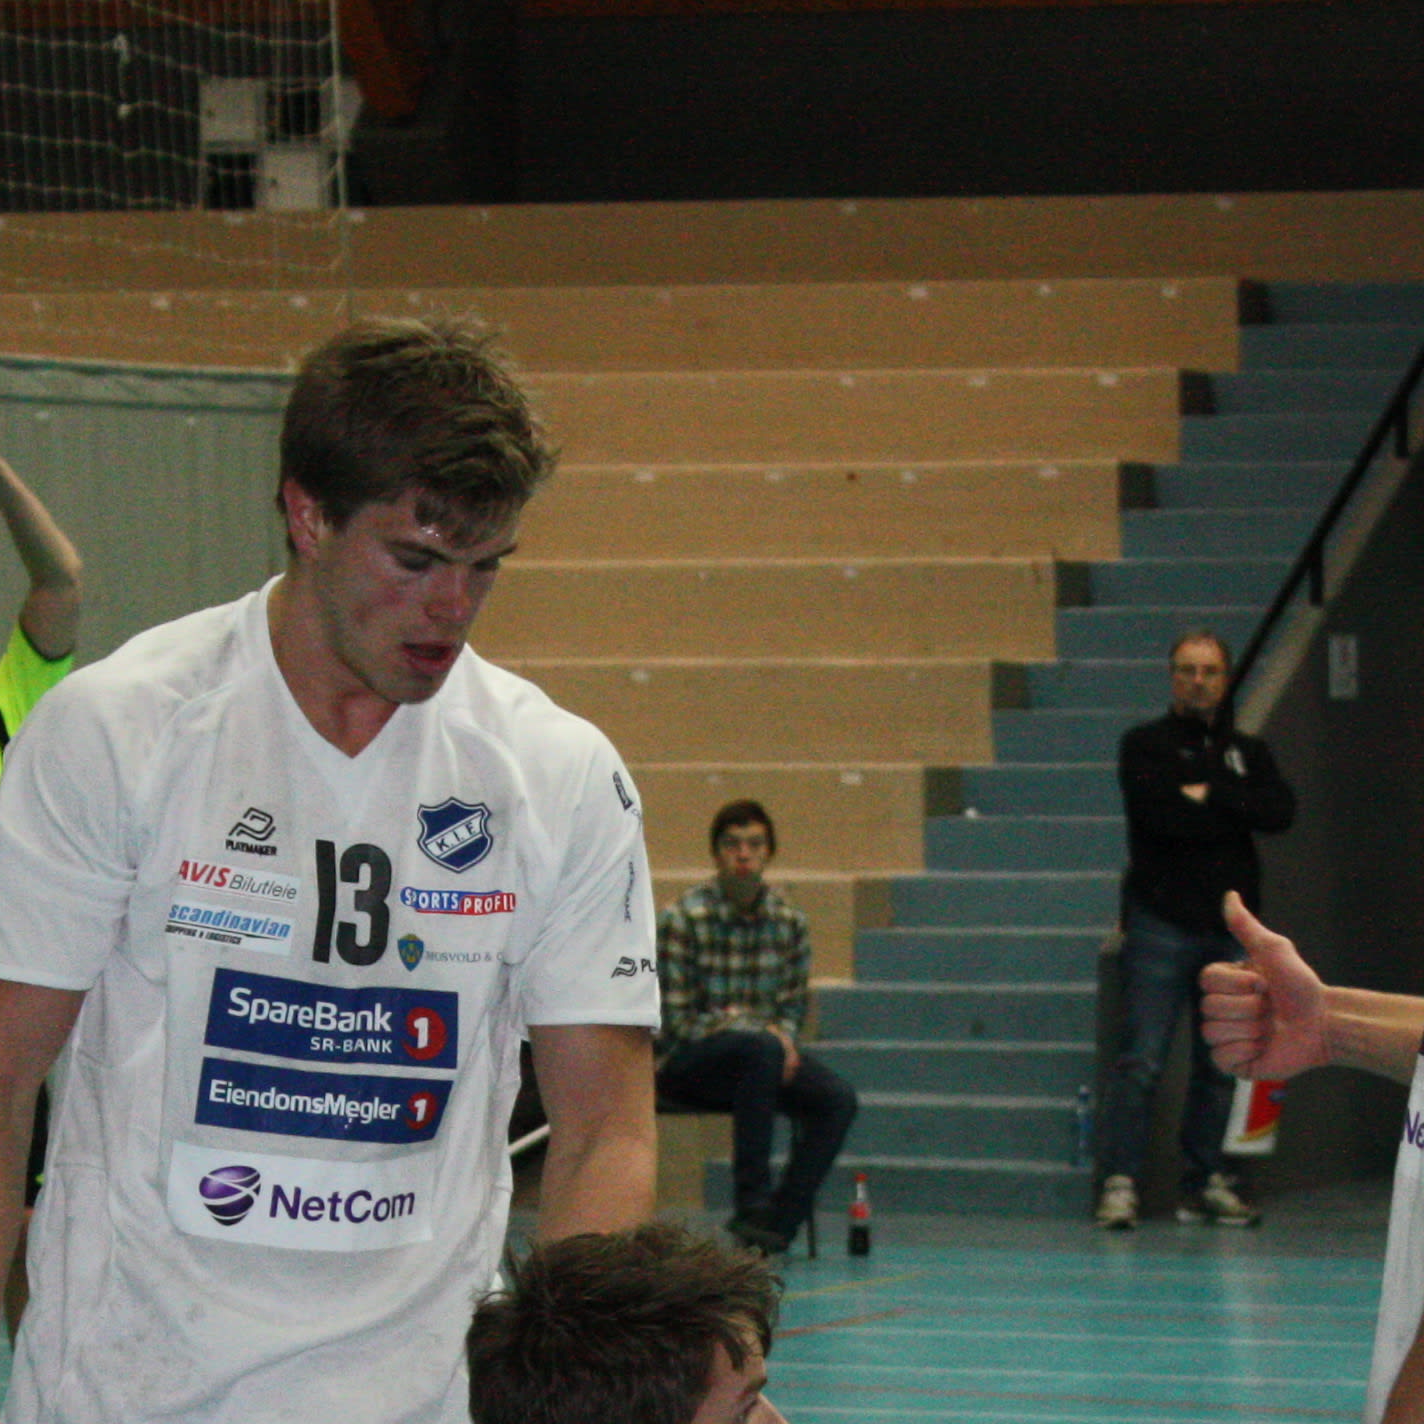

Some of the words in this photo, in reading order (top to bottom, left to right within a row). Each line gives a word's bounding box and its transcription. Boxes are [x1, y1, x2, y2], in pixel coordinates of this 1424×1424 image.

[226, 839, 277, 856] PLAYMAKER
[178, 860, 231, 887] AVIS
[228, 874, 297, 899] Bilutleie
[168, 903, 291, 938] scandinavian
[312, 839, 392, 966] 13
[403, 888, 459, 910] SPORTS
[462, 892, 516, 914] PROFIL
[227, 986, 392, 1032] SpareBank
[413, 1017, 429, 1049] 1
[310, 1036, 392, 1054] SR-BANK
[208, 1079, 400, 1124] EiendomsMegler
[414, 1098, 427, 1122] 1
[269, 1184, 415, 1223] NetCom
